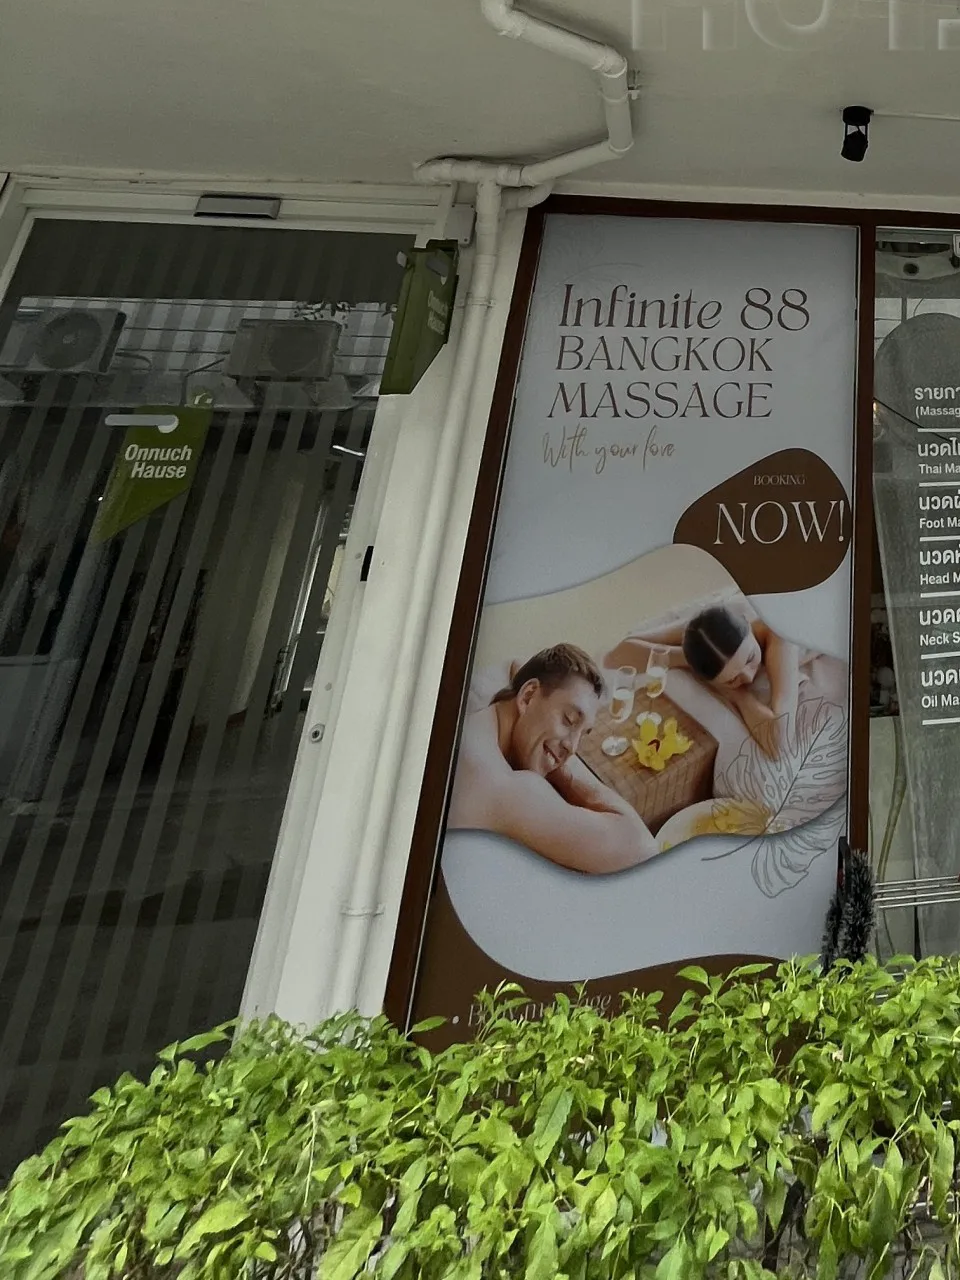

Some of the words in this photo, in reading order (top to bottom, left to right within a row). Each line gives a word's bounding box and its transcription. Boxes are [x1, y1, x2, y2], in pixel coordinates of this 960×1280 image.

[558, 283, 723, 330] Infinite
[740, 287, 811, 331] 88
[555, 335, 774, 372] BANGKOK
[547, 381, 773, 419] MASSAGE
[125, 444, 193, 461] Onnuch
[542, 422, 589, 474] With
[594, 442, 639, 475] your
[642, 424, 677, 472] love
[130, 462, 187, 479] Hause
[918, 463, 942, 474] Thai
[753, 474, 806, 486] BOOKING
[713, 500, 845, 545] NOW!
[920, 517, 944, 529] Foot
[920, 572, 950, 585] Head
[920, 632, 950, 646] Neck
[921, 696, 938, 708] Oil
